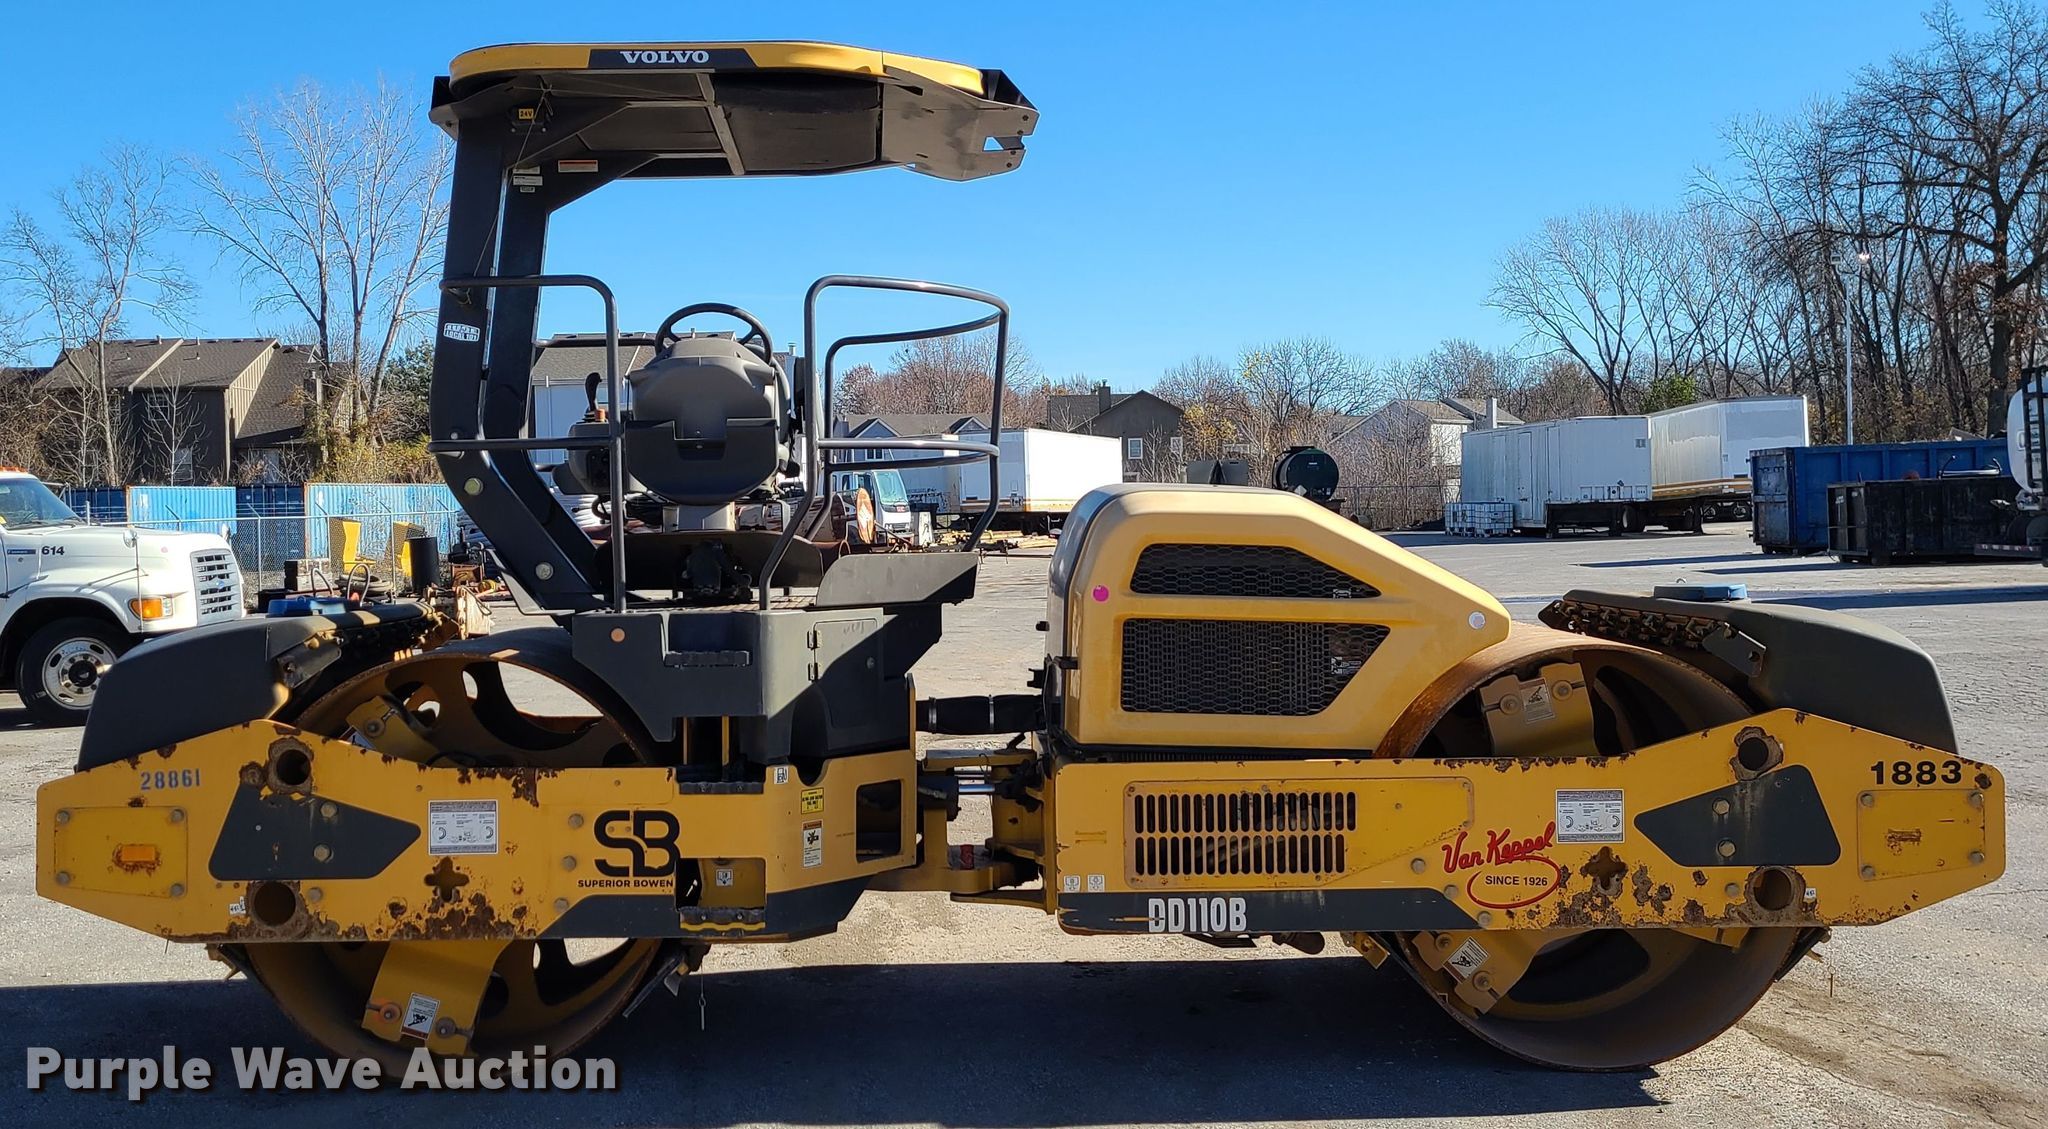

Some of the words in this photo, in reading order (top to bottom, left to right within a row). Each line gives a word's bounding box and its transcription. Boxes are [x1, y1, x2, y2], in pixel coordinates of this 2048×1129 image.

[620, 50, 709, 64] VOLVO
[519, 110, 534, 119] 24V
[41, 545, 65, 555] 614
[141, 768, 201, 790] 28861
[1870, 760, 1962, 785] 1883
[594, 810, 681, 877] SB
[1441, 831, 1485, 873] Van
[1486, 821, 1556, 865] Keppel
[577, 879, 631, 888] SUPERIOR
[633, 879, 673, 888] BOWEN
[1485, 875, 1520, 885] SINCE
[1523, 876, 1548, 886] 1926
[1148, 897, 1247, 932] DD110B
